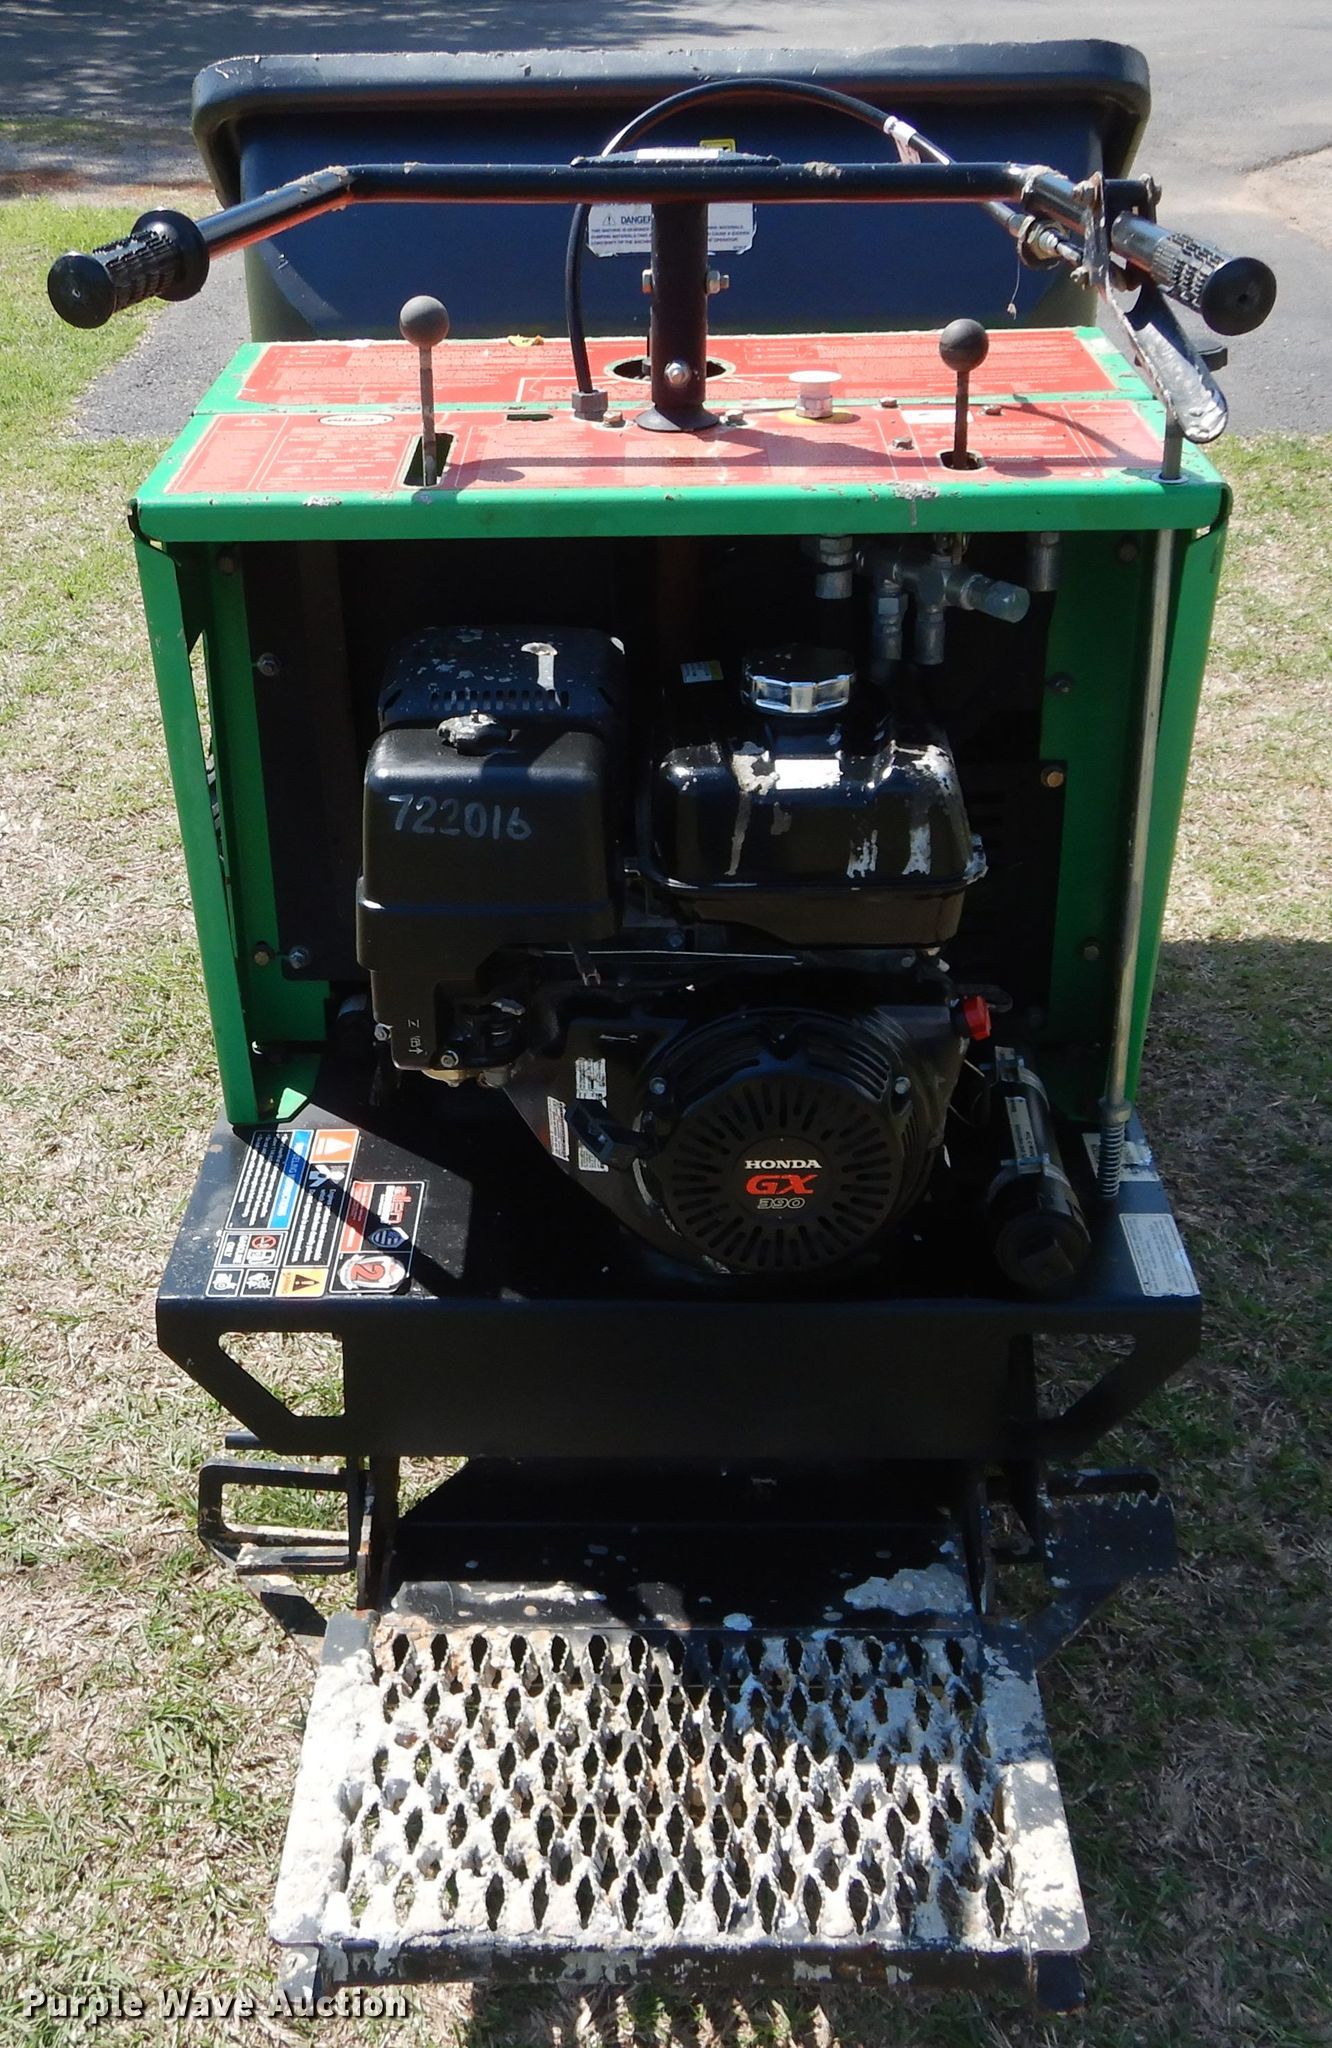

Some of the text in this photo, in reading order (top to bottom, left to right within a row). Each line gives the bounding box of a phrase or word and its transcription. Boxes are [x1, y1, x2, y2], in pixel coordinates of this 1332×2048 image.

[389, 794, 531, 840] 722016
[745, 1159, 822, 1169] HONDA
[745, 1173, 818, 1195] GX
[757, 1197, 805, 1209] 390
[350, 1263, 387, 1282] 2
